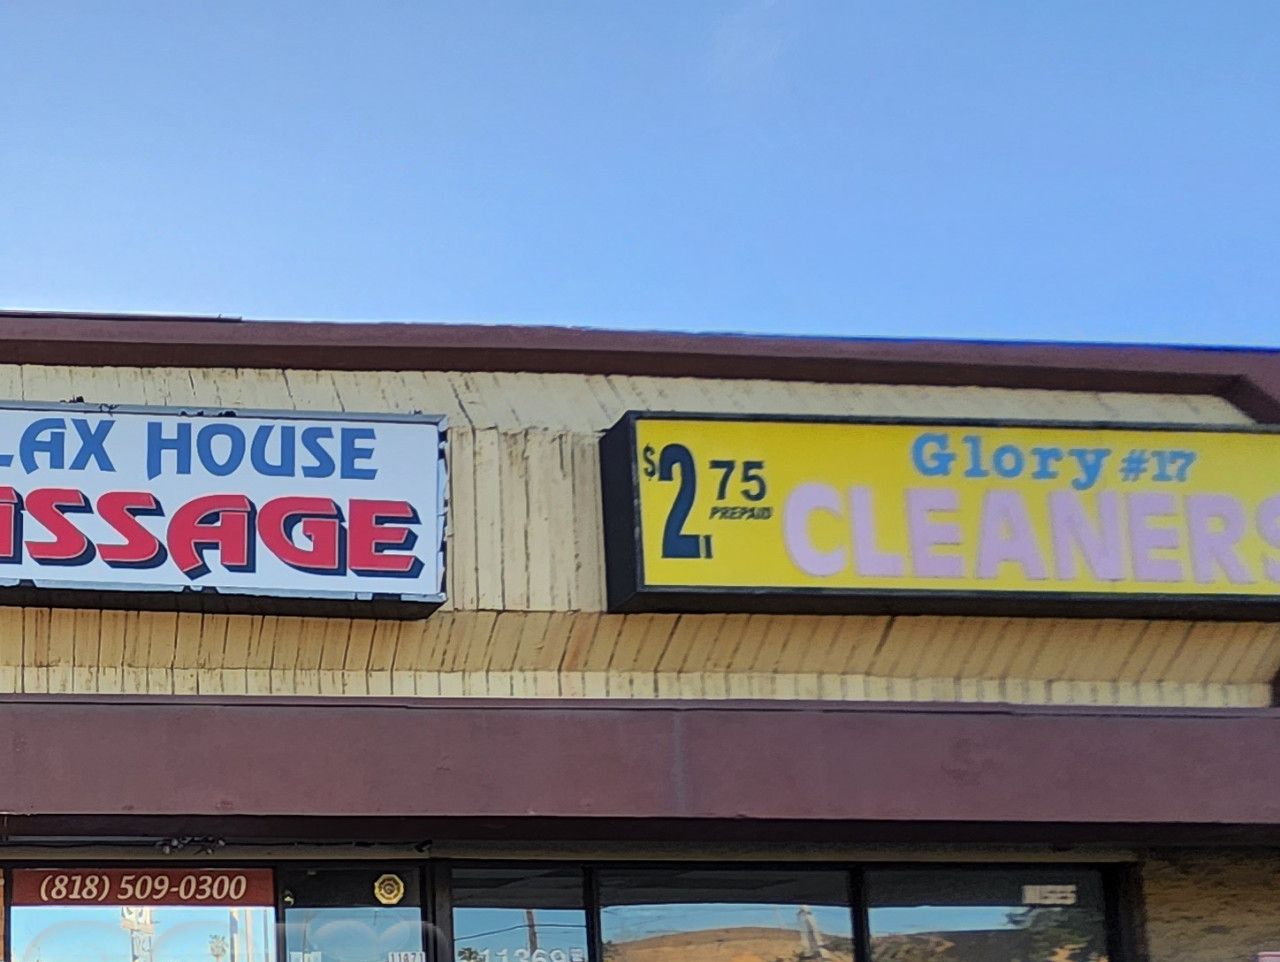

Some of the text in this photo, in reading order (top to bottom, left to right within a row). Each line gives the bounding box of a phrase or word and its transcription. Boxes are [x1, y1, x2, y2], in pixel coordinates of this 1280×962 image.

[147, 420, 378, 480] HOUSE
[911, 433, 1198, 490] Glory #17
[709, 506, 773, 520] PREPAID
[40, 875, 247, 901] (818) 509-0300
